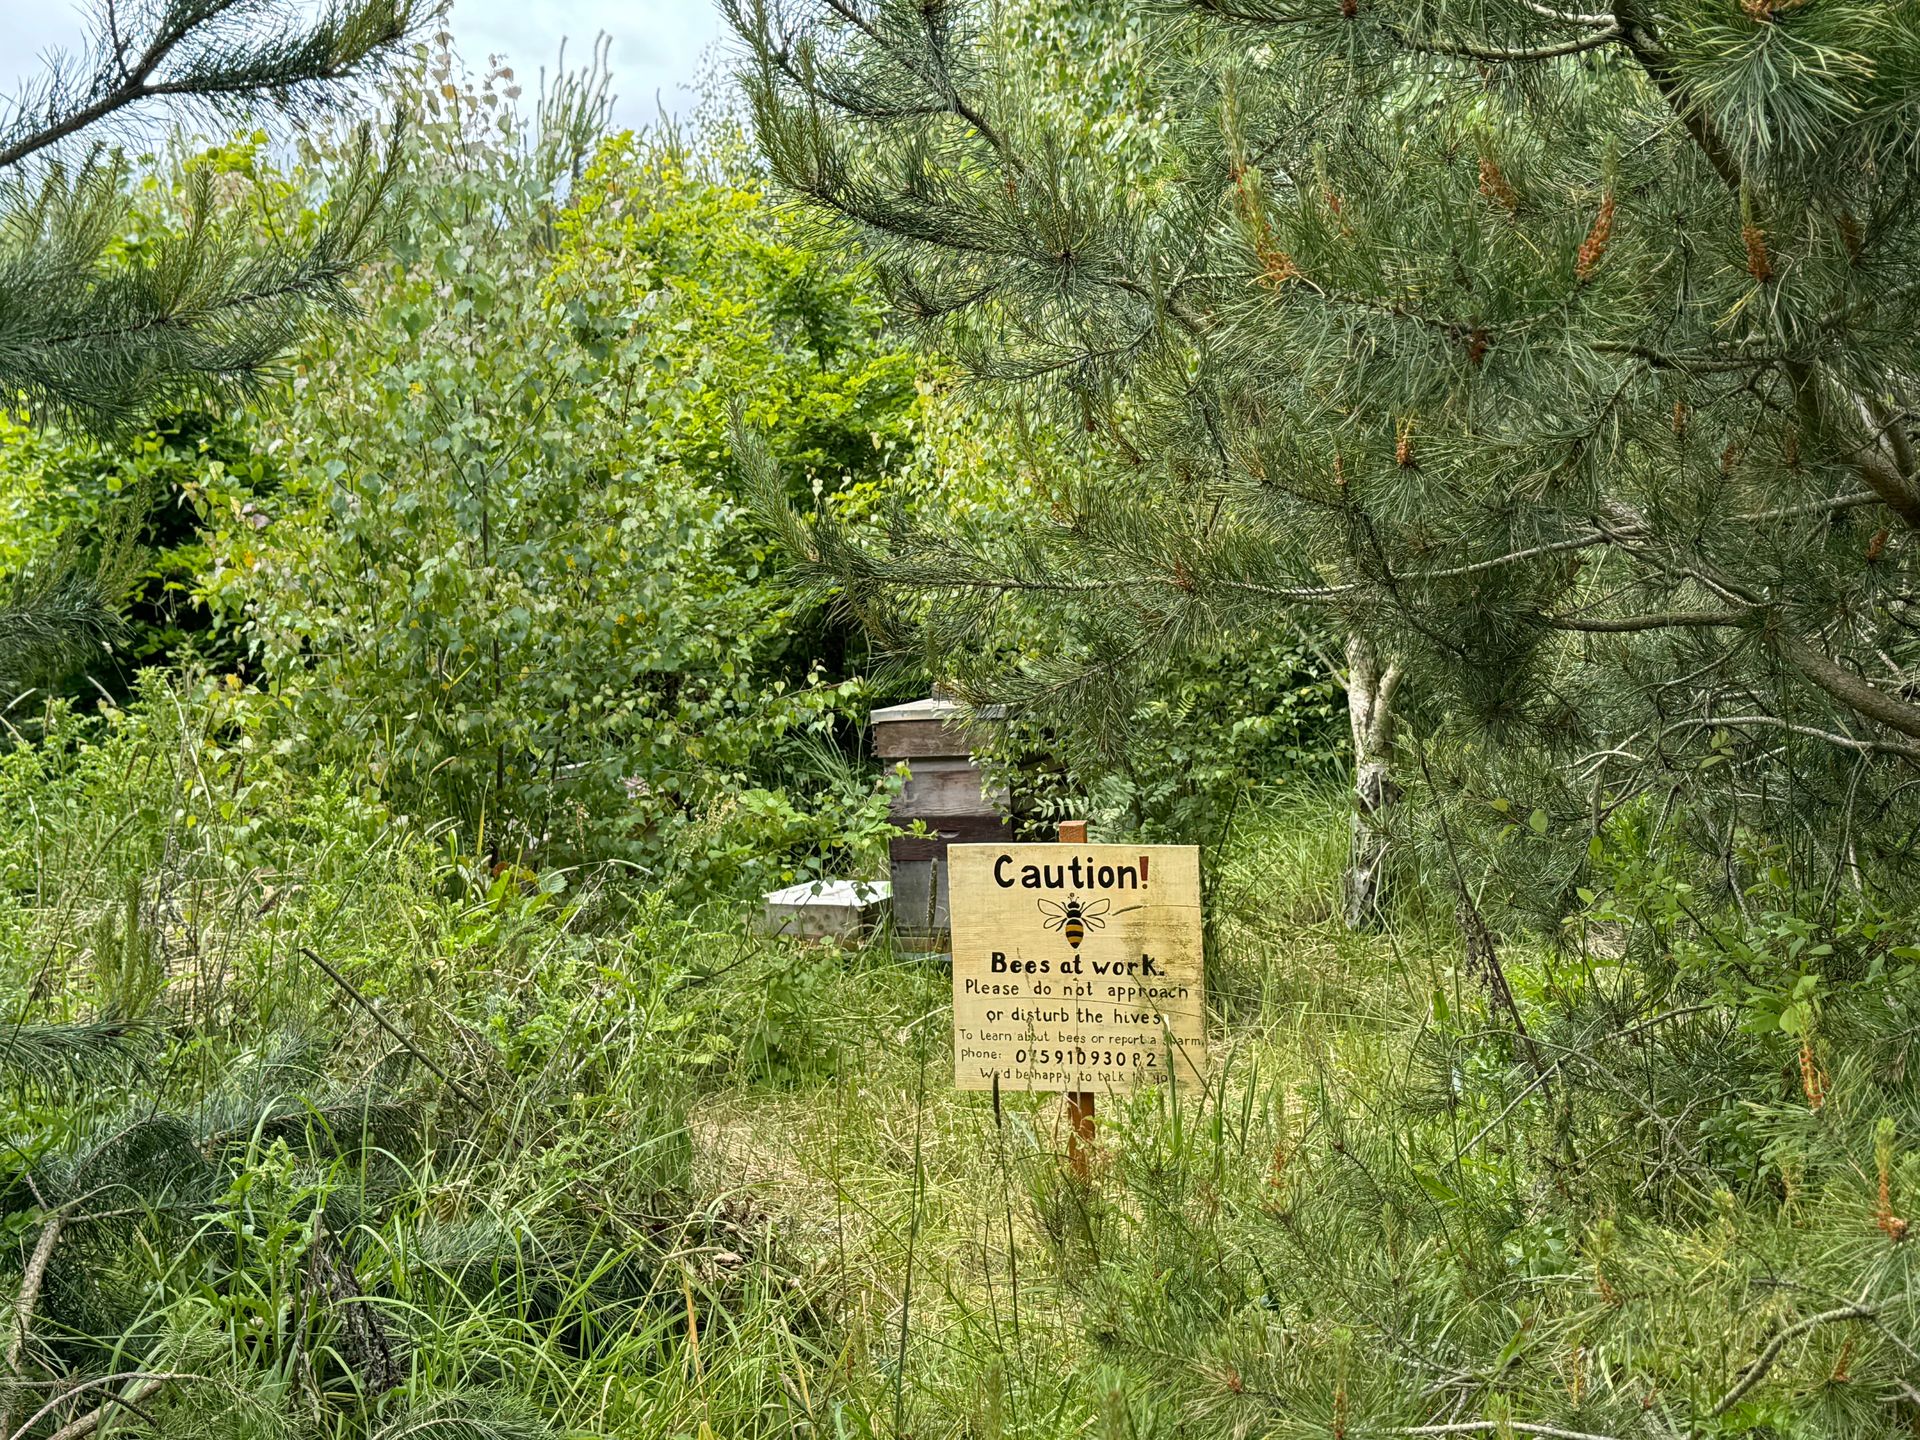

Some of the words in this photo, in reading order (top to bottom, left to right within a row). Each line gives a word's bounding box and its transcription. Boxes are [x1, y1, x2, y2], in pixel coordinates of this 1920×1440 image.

[994, 854, 1149, 889] Caution!
[991, 952, 1050, 974] Bees
[1060, 954, 1083, 975] at
[1092, 954, 1165, 976] work.
[965, 979, 1019, 996] Please
[1033, 980, 1051, 995] do
[1063, 981, 1093, 996] not
[1108, 984, 1188, 1002] approach
[986, 1009, 1004, 1022] or
[1011, 1007, 1069, 1022] disturb
[1077, 1008, 1103, 1023] the
[959, 1028, 973, 1040] To
[980, 1029, 1012, 1041] learn
[1058, 1031, 1086, 1043] bees
[1091, 1035, 1104, 1044] or
[1109, 1034, 1146, 1046] report
[1150, 1036, 1157, 1045] a
[961, 1047, 1002, 1062] phone:
[1015, 1068, 1029, 1080] be
[1035, 1069, 1071, 1083] happy
[1079, 1071, 1092, 1082] to
[1098, 1071, 1124, 1082] talk
